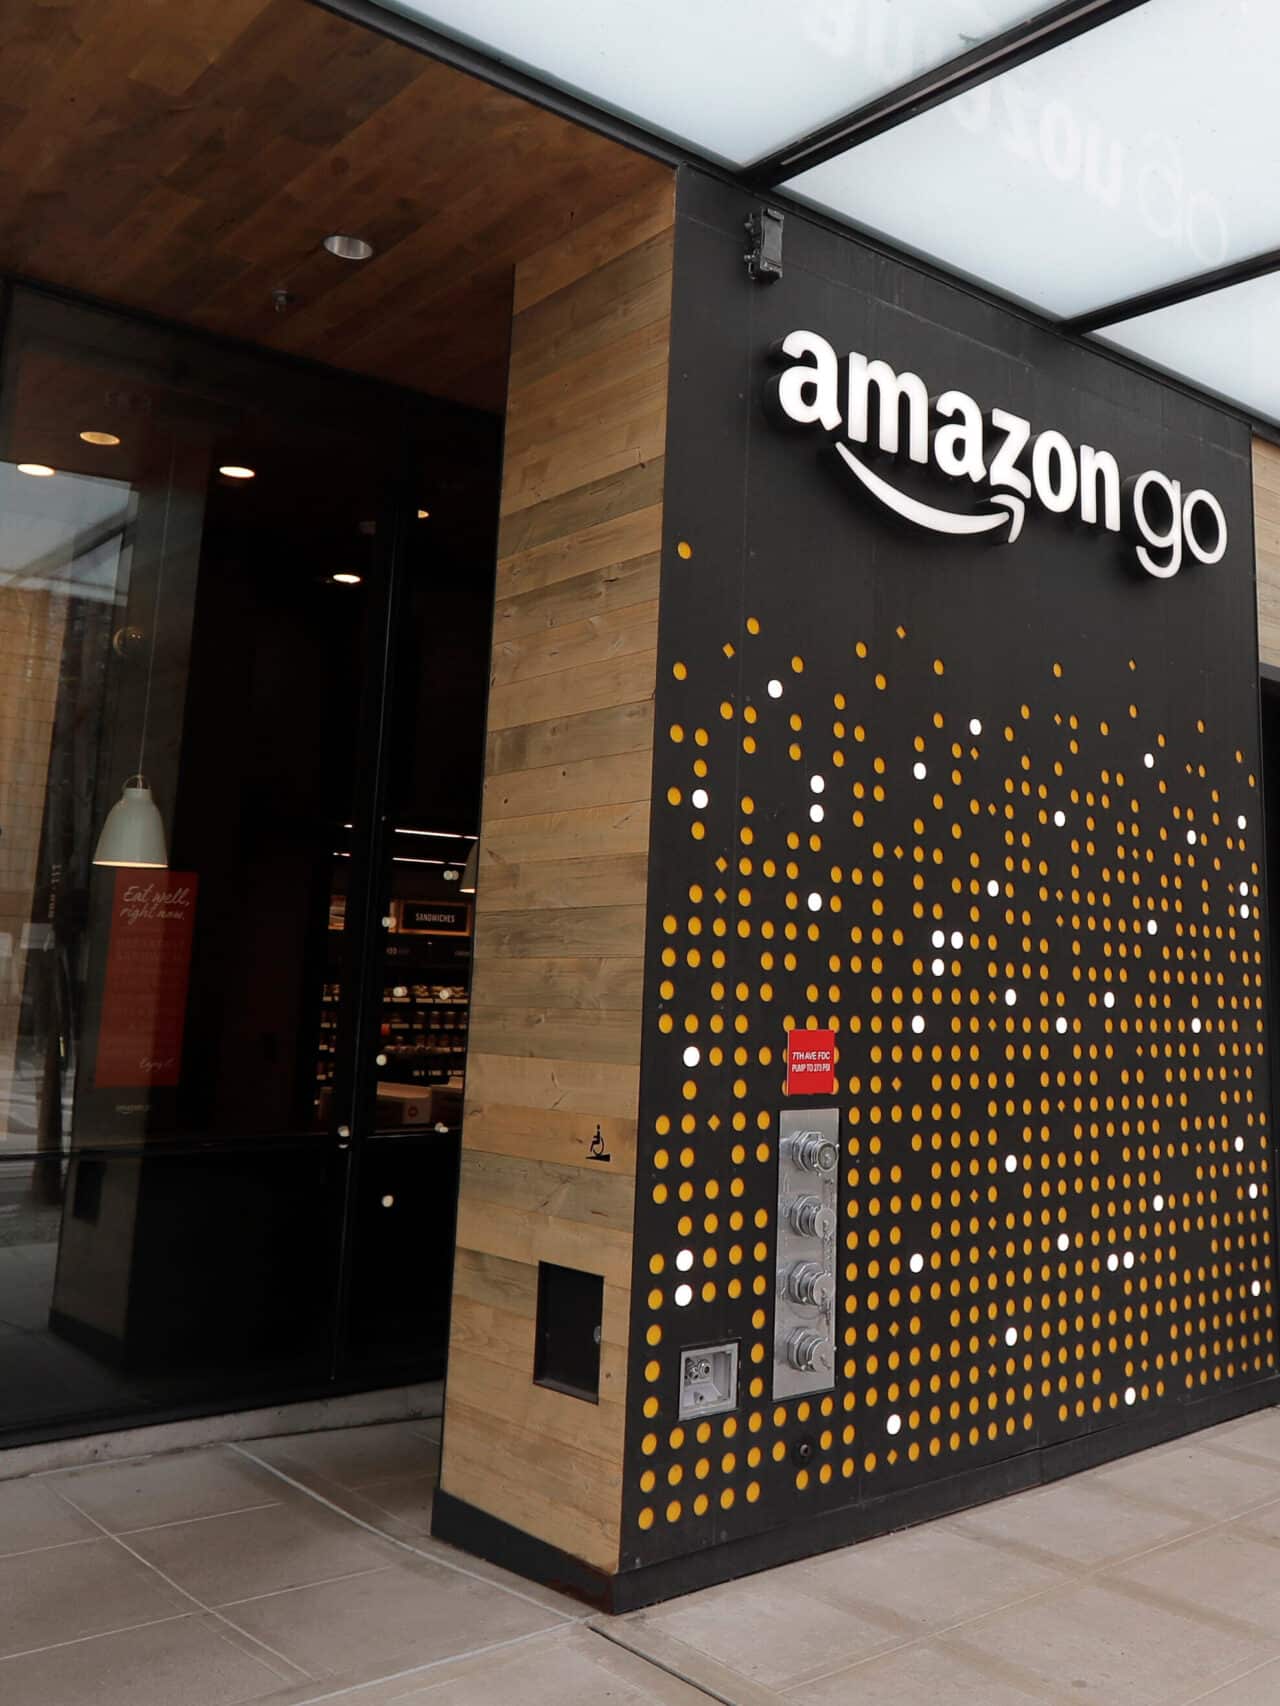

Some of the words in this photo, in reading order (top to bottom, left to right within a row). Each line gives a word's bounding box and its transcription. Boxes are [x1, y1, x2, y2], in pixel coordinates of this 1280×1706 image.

[778, 329, 1121, 534] amazon
[1132, 469, 1228, 579] go
[123, 883, 154, 902] Eat
[151, 887, 191, 907] well,
[415, 913, 455, 923] SANDWICHES
[791, 1051, 804, 1060] 7TH
[803, 1051, 817, 1060] AVE
[817, 1051, 831, 1060] FDC
[791, 1063, 807, 1072] PUMP
